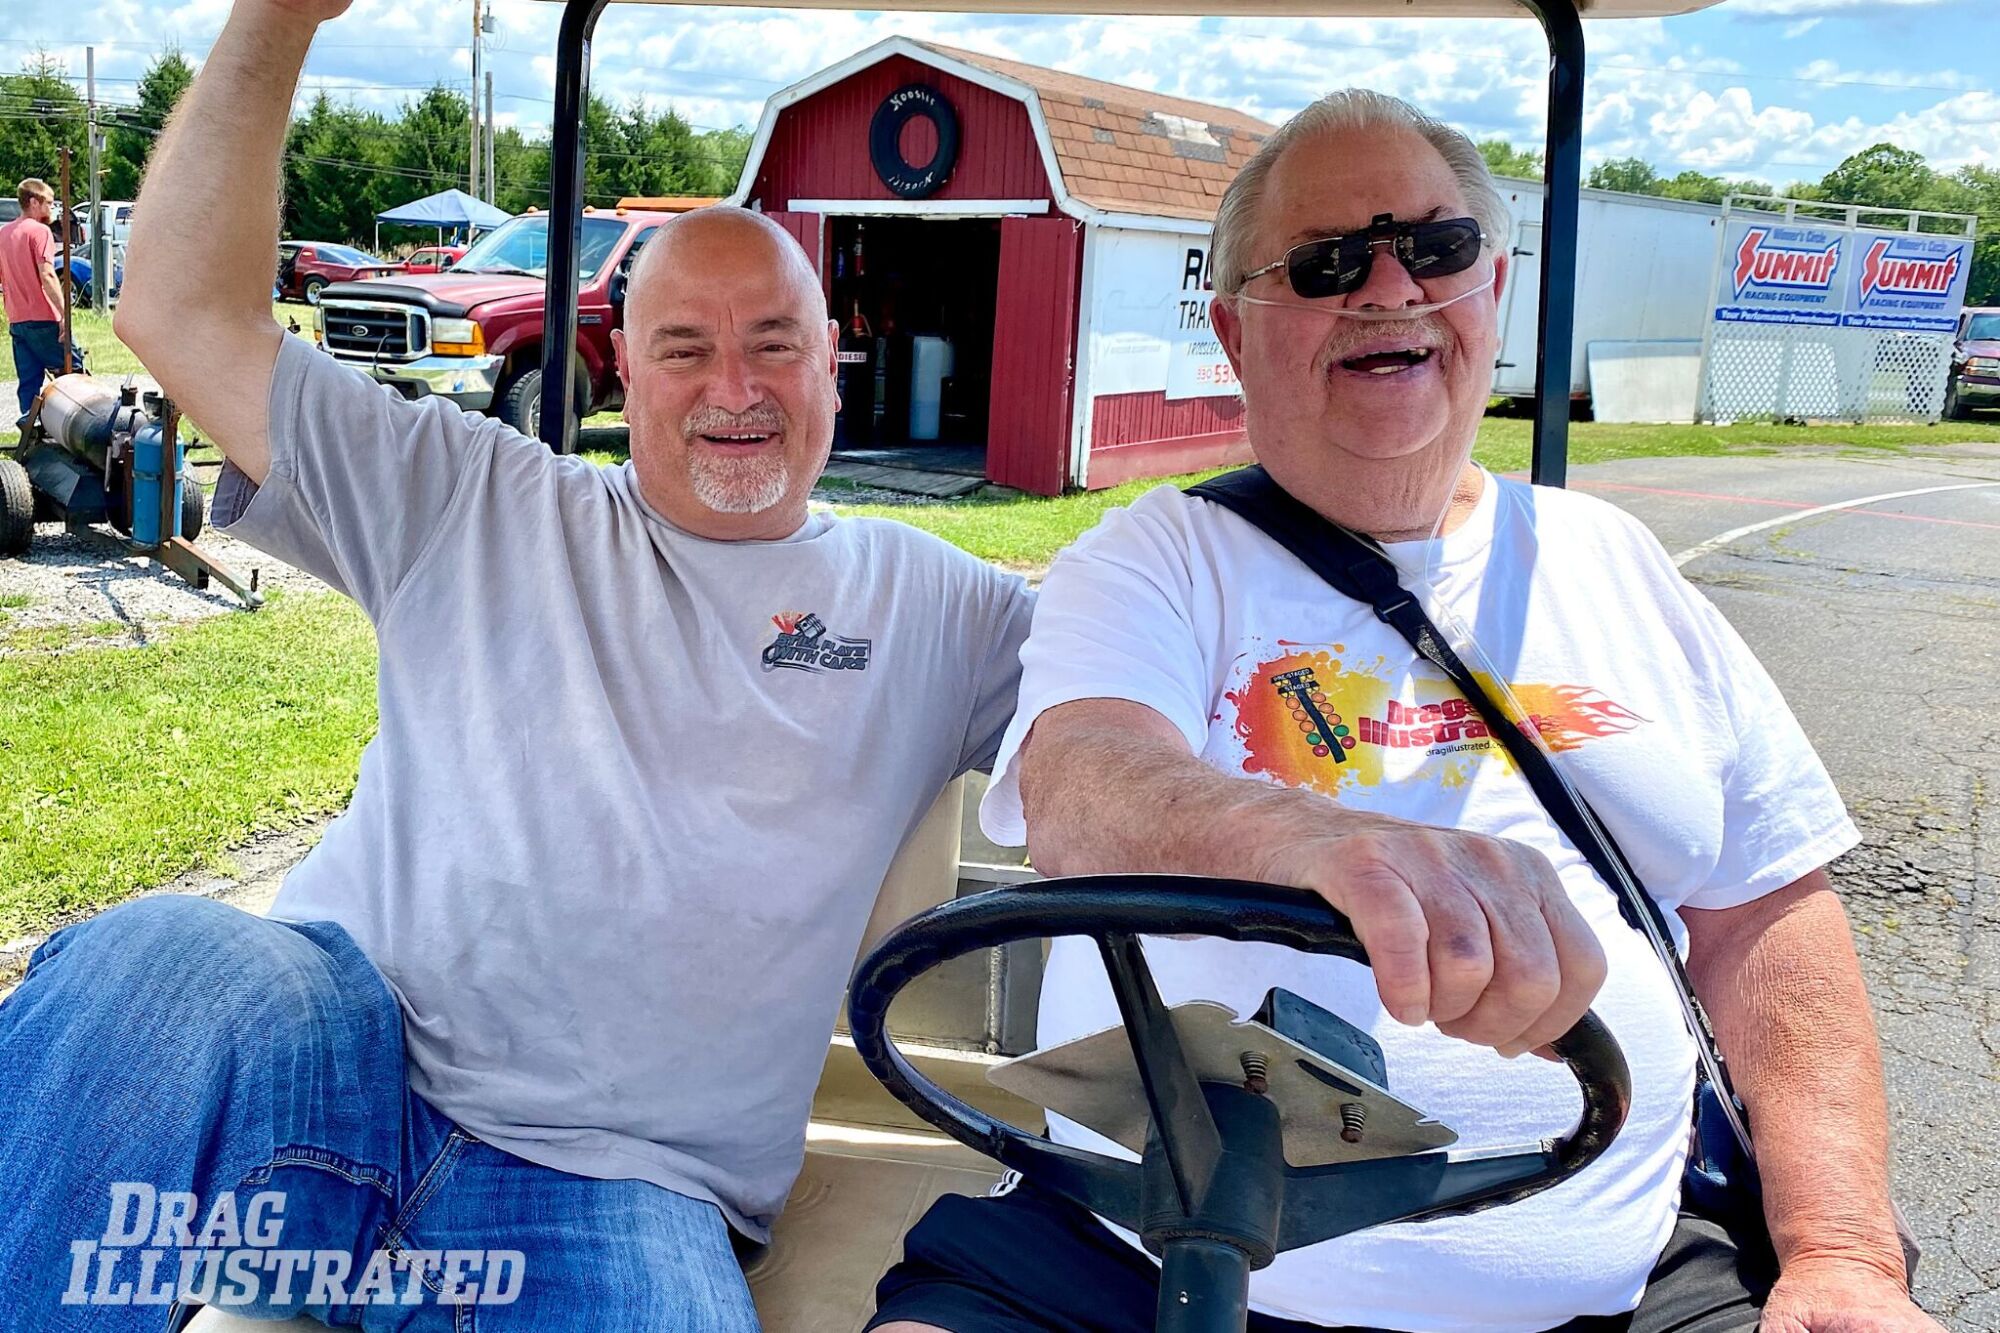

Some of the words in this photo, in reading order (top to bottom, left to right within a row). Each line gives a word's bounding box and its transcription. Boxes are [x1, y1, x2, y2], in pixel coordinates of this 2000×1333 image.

[1744, 291, 1777, 300] RACING
[1778, 293, 1828, 303] EQUIPMENT
[773, 645, 820, 664] WITH
[820, 653, 868, 670] CARS
[821, 639, 868, 657] PLAYS
[1387, 698, 1468, 726] Drag
